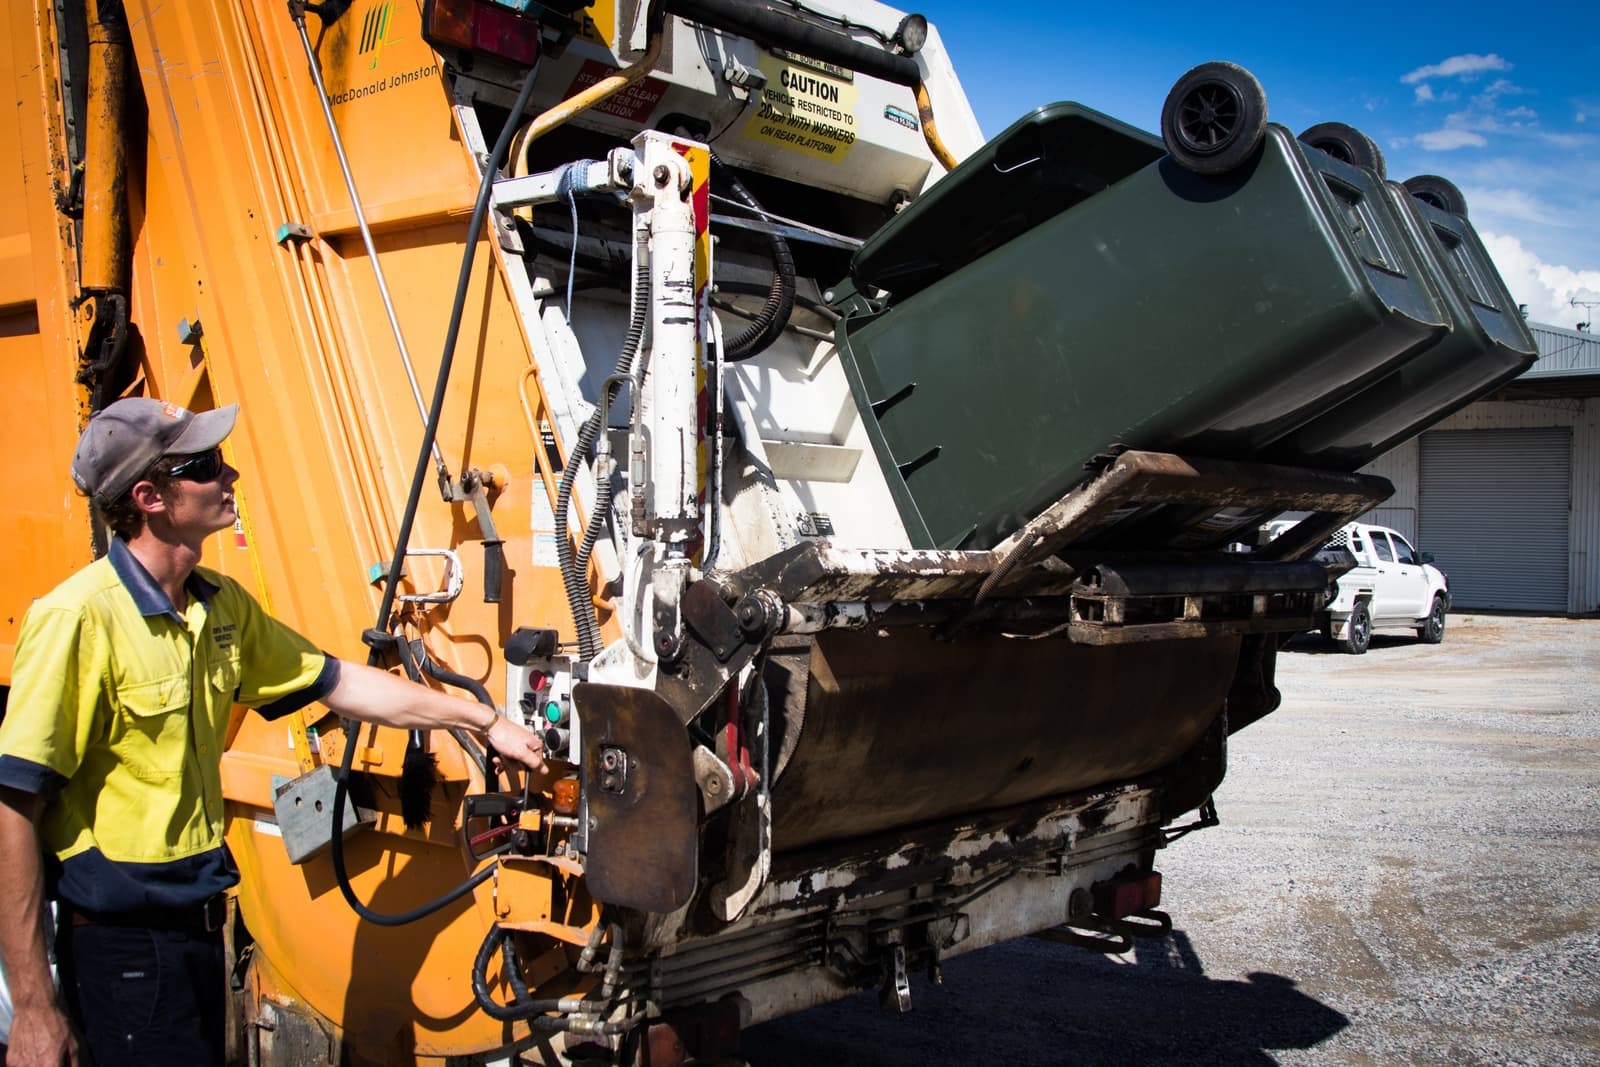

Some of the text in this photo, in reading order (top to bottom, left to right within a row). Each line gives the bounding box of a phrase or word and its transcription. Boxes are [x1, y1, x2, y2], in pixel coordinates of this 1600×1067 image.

[328, 64, 438, 107] MacDonald Johnston
[627, 87, 658, 103] CLEAR
[780, 69, 839, 103] CAUTION
[757, 102, 856, 145] 20kph WITH WORKERS
[763, 87, 854, 125] VEHICLE RESTRICTED TO
[760, 126, 837, 154] ON REAR PLATFORM
